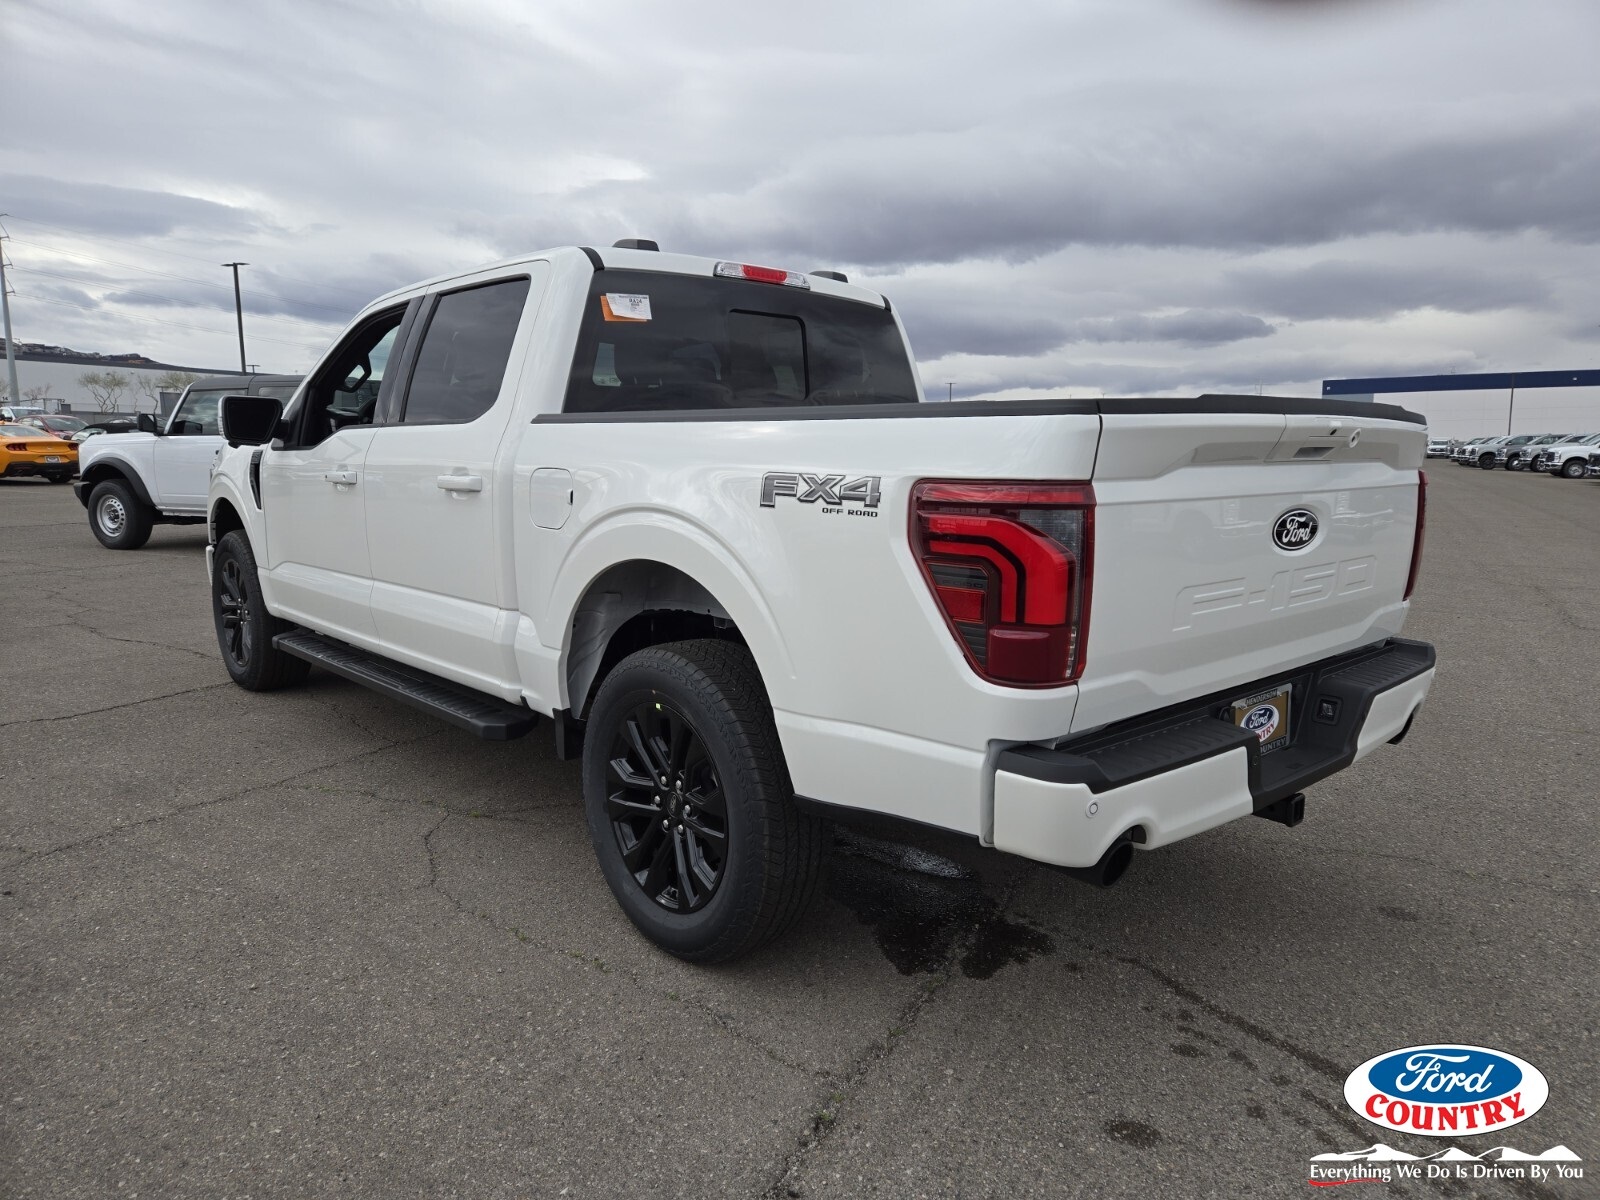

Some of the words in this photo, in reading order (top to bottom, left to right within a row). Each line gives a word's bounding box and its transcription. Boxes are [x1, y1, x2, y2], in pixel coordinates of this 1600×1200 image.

[760, 471, 882, 508] FX4
[848, 509, 878, 518] ROAD
[1282, 515, 1312, 544] Ford
[1172, 554, 1377, 632] F-150
[1246, 688, 1278, 705] HENDERSON
[1250, 710, 1270, 728] Ford
[1256, 722, 1275, 741] NTRY
